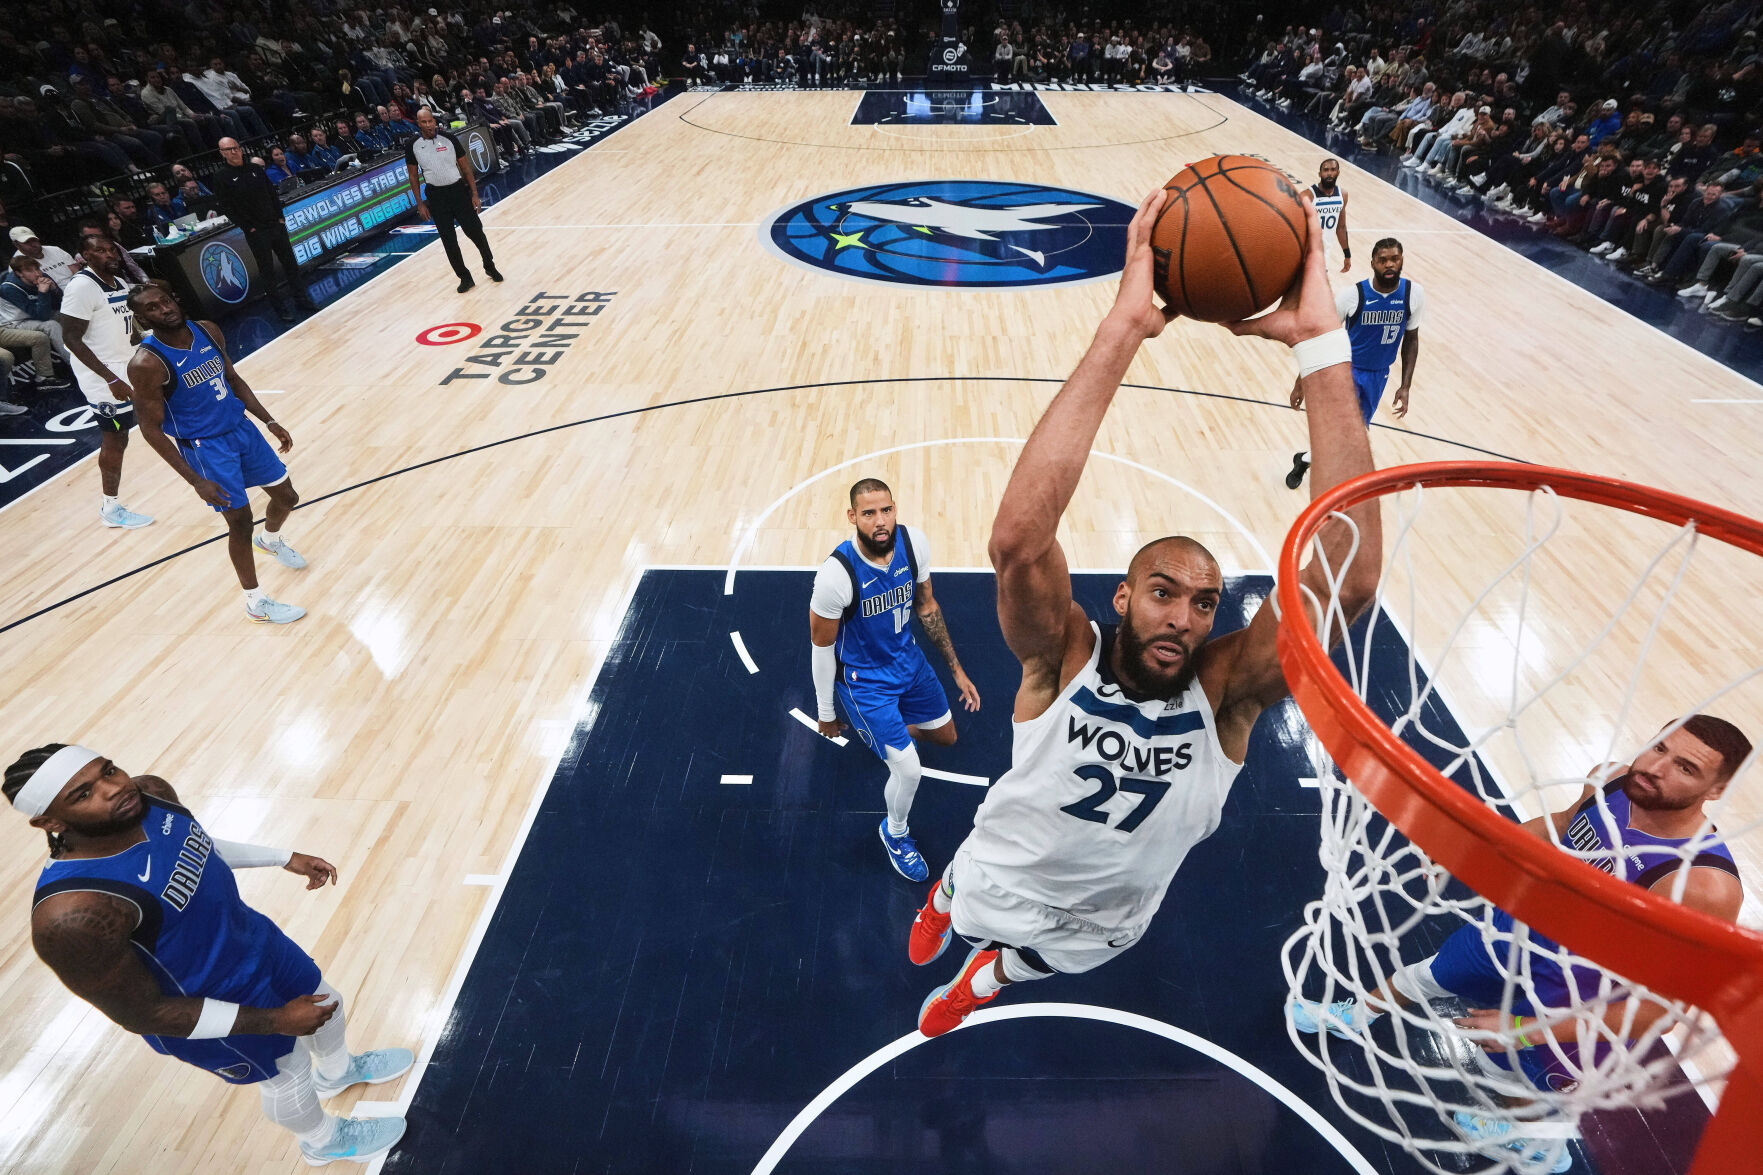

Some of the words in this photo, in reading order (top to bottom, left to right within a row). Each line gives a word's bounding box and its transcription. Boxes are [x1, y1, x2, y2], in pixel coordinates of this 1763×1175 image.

[990, 82, 1214, 93] MINNESOTA
[284, 185, 362, 232] ERWOLVES
[1320, 215, 1337, 230] 10
[293, 236, 323, 265] BIG
[360, 193, 410, 231] BIGGER
[1361, 310, 1405, 326] DALLAS
[1380, 325, 1401, 345] 13
[438, 291, 570, 386] TARGET
[497, 291, 618, 386] CENTER
[182, 355, 224, 389] DALLAS
[894, 565, 909, 578] chime
[862, 579, 913, 618] DALLAS
[892, 600, 913, 635] 16
[1164, 699, 1184, 712] zzle
[1068, 714, 1193, 777] WOLVES
[1060, 764, 1172, 834] 27
[160, 821, 212, 913] DALLAS
